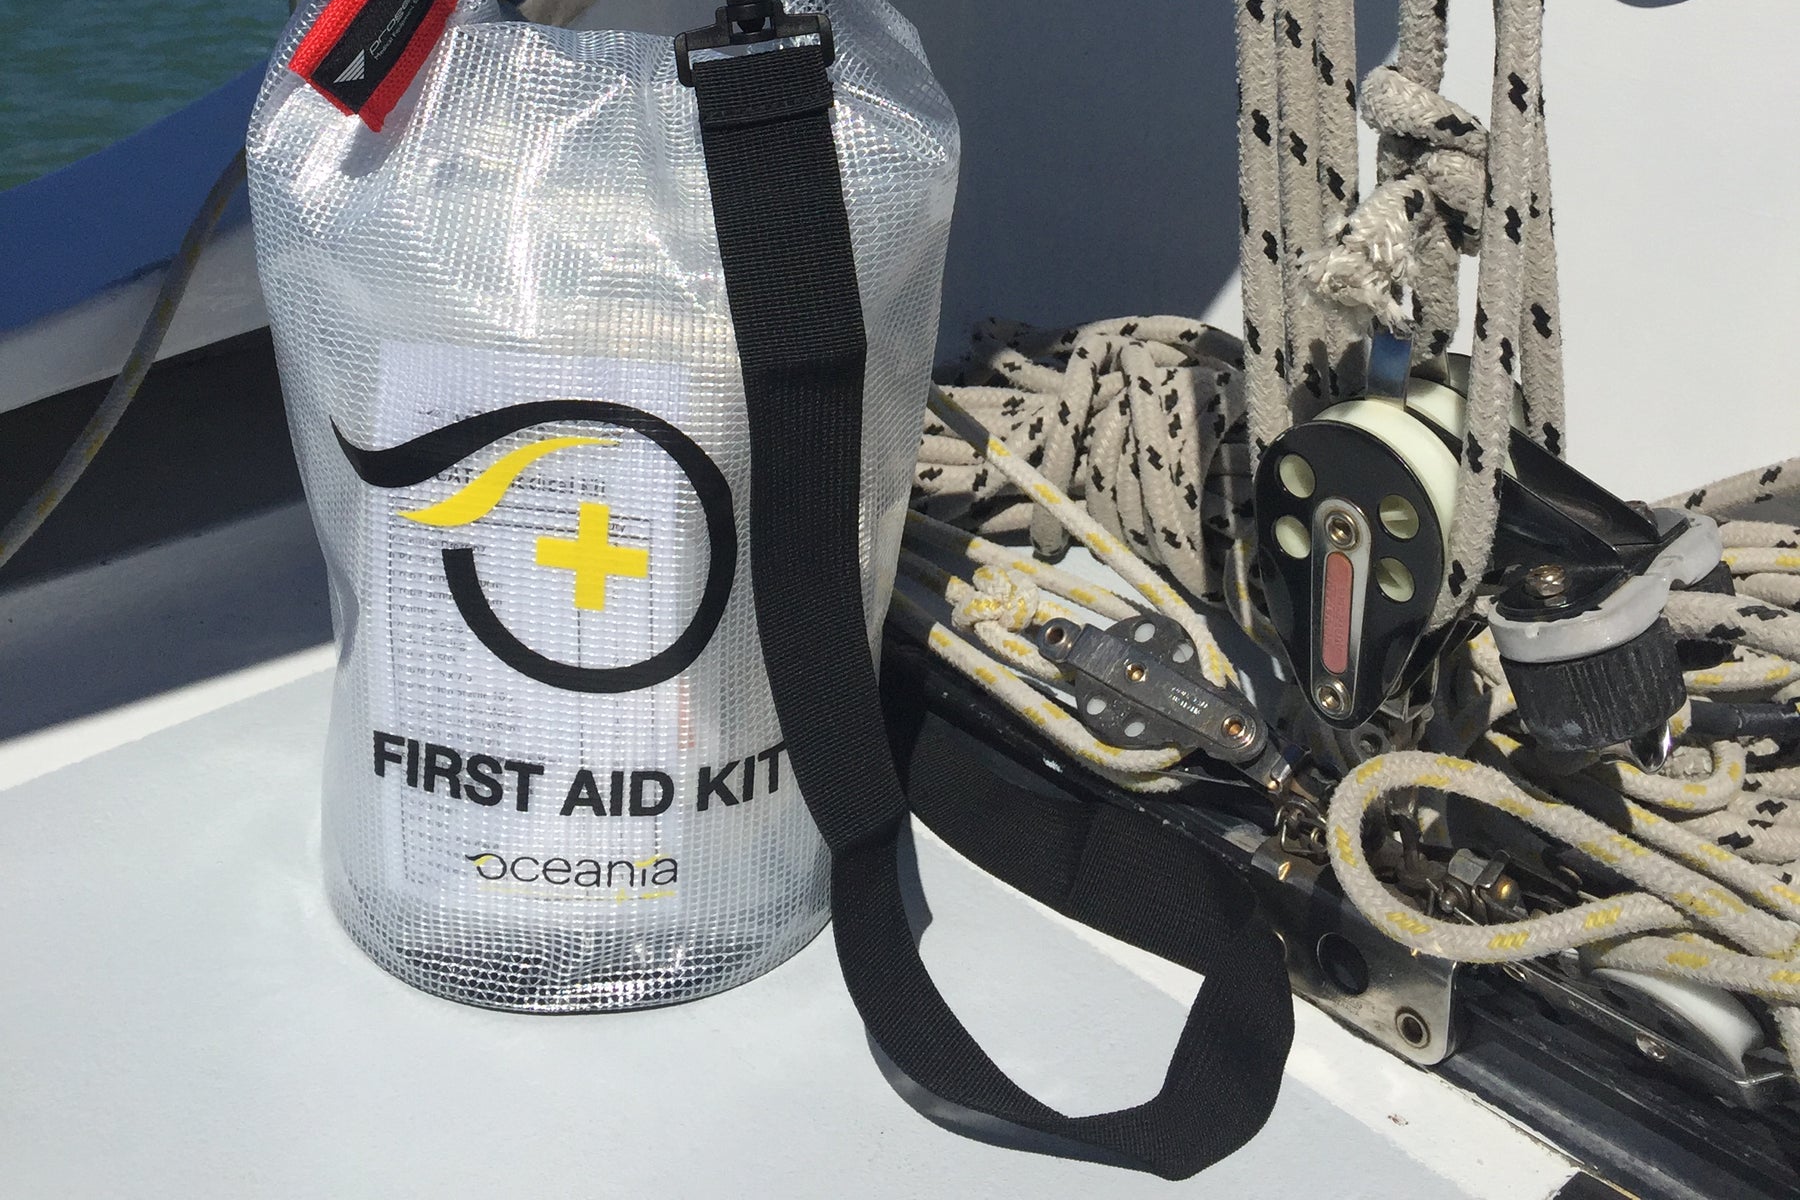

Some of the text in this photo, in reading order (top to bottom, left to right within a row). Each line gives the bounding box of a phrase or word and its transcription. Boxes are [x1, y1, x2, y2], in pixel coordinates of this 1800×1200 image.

[373, 731, 789, 817] FIRST AID KIT
